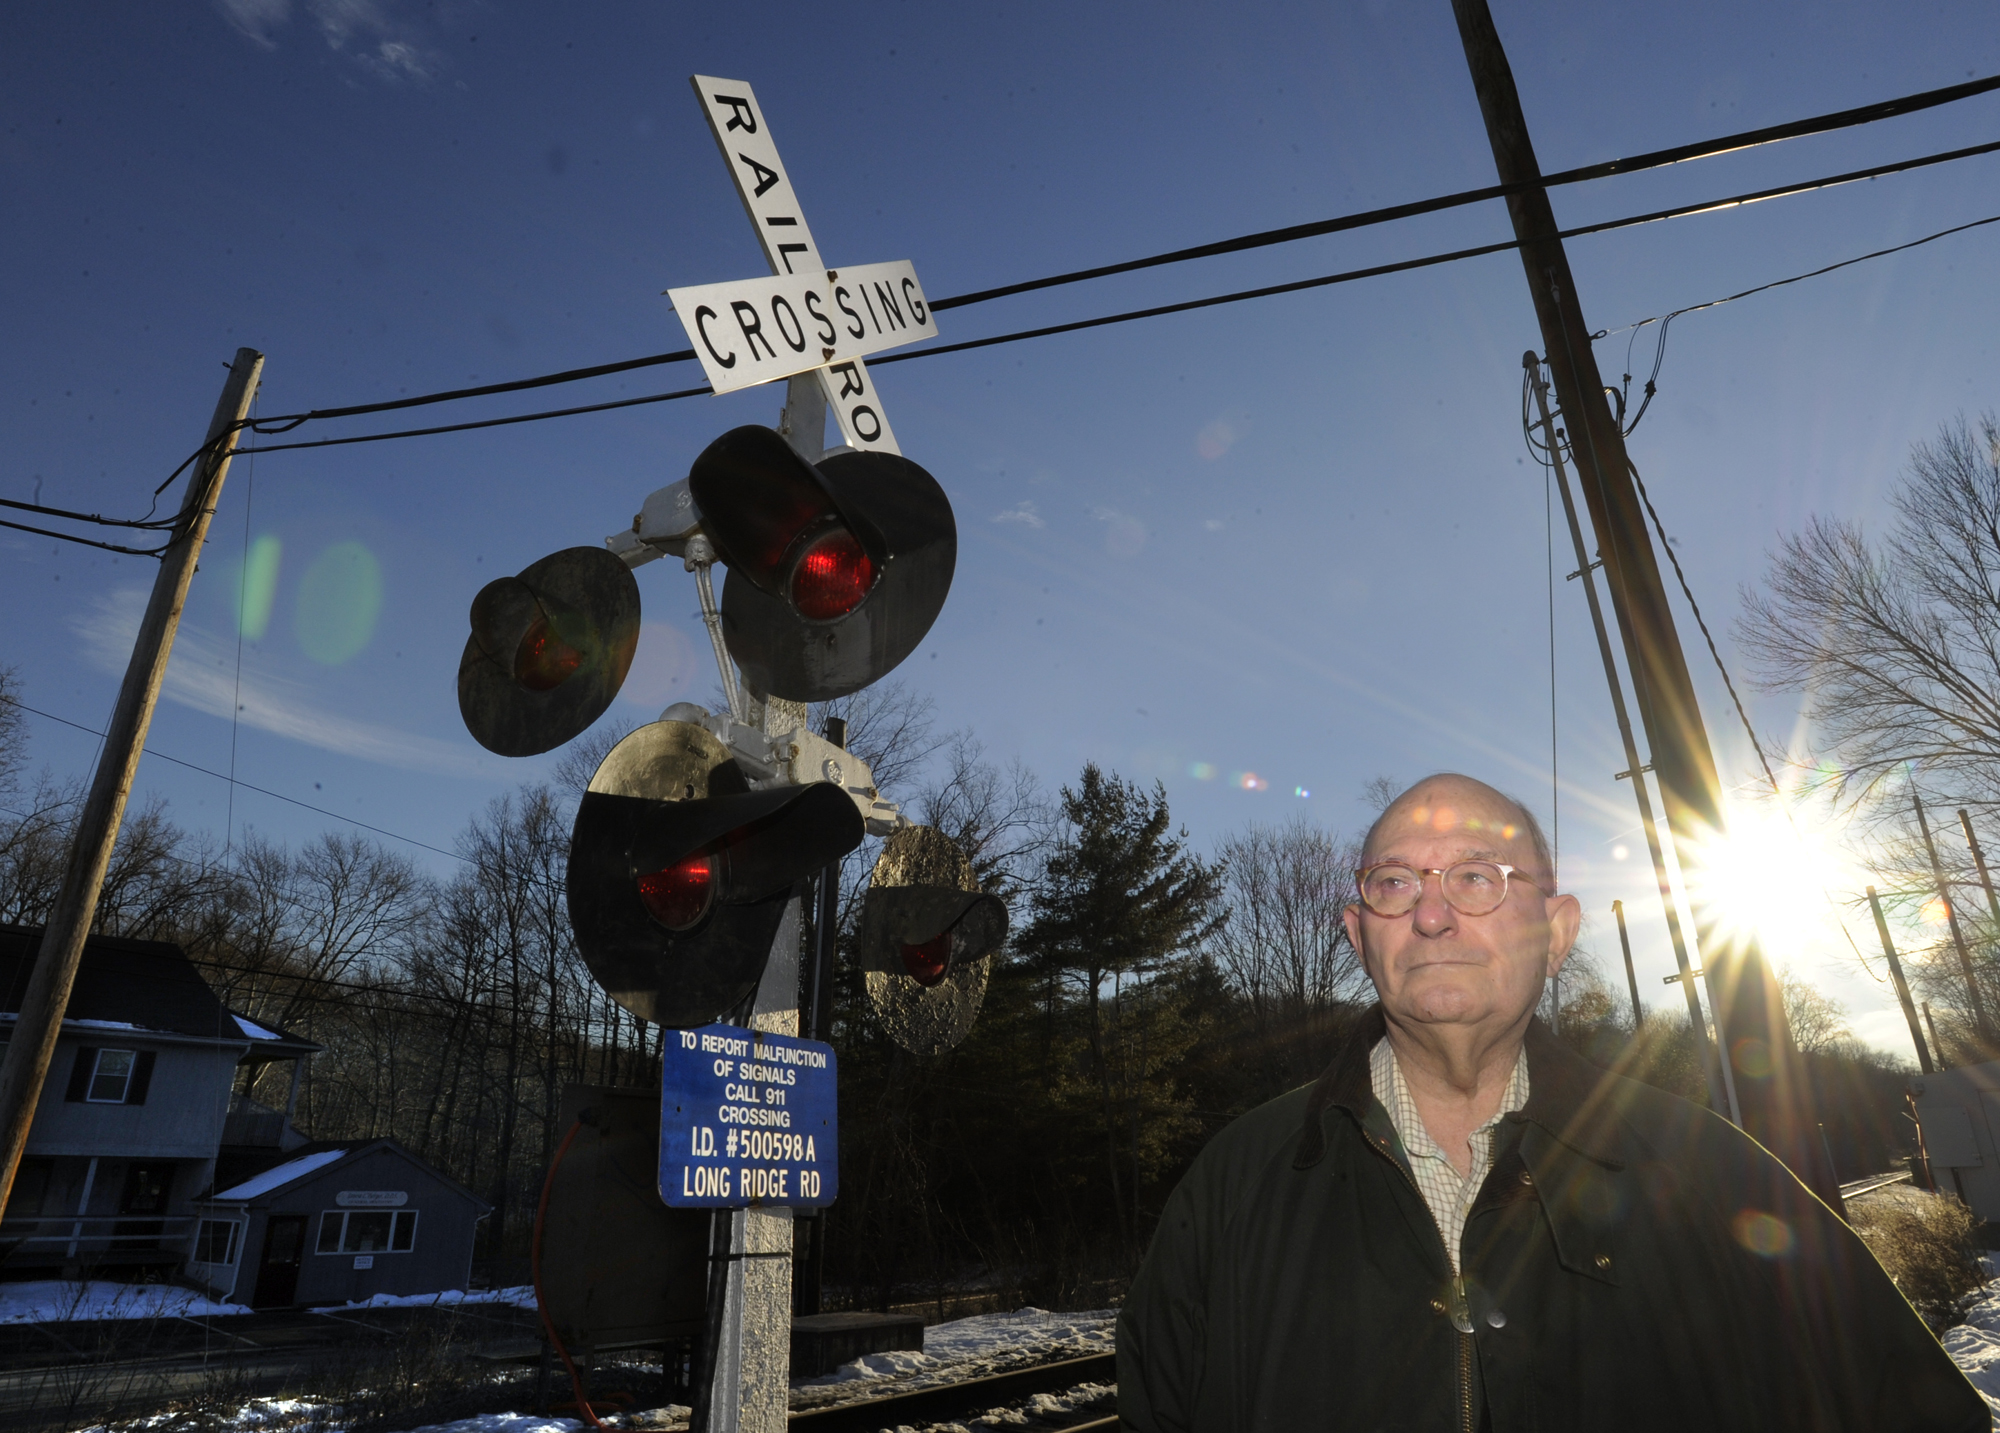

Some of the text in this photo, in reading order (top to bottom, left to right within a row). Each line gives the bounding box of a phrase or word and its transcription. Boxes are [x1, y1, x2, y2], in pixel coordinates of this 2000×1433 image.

[694, 277, 927, 369] CROSSING
[829, 360, 882, 442] RO
[679, 1030, 826, 1068] TO REPORT MALFUNCTION
[713, 1059, 796, 1086] OF SIGNALS
[725, 1083, 785, 1105] CALL 911
[719, 1105, 790, 1127] CROSSING
[691, 1126, 816, 1162] I.D. #500598A
[683, 1166, 821, 1198] LONG RIDGE RD
